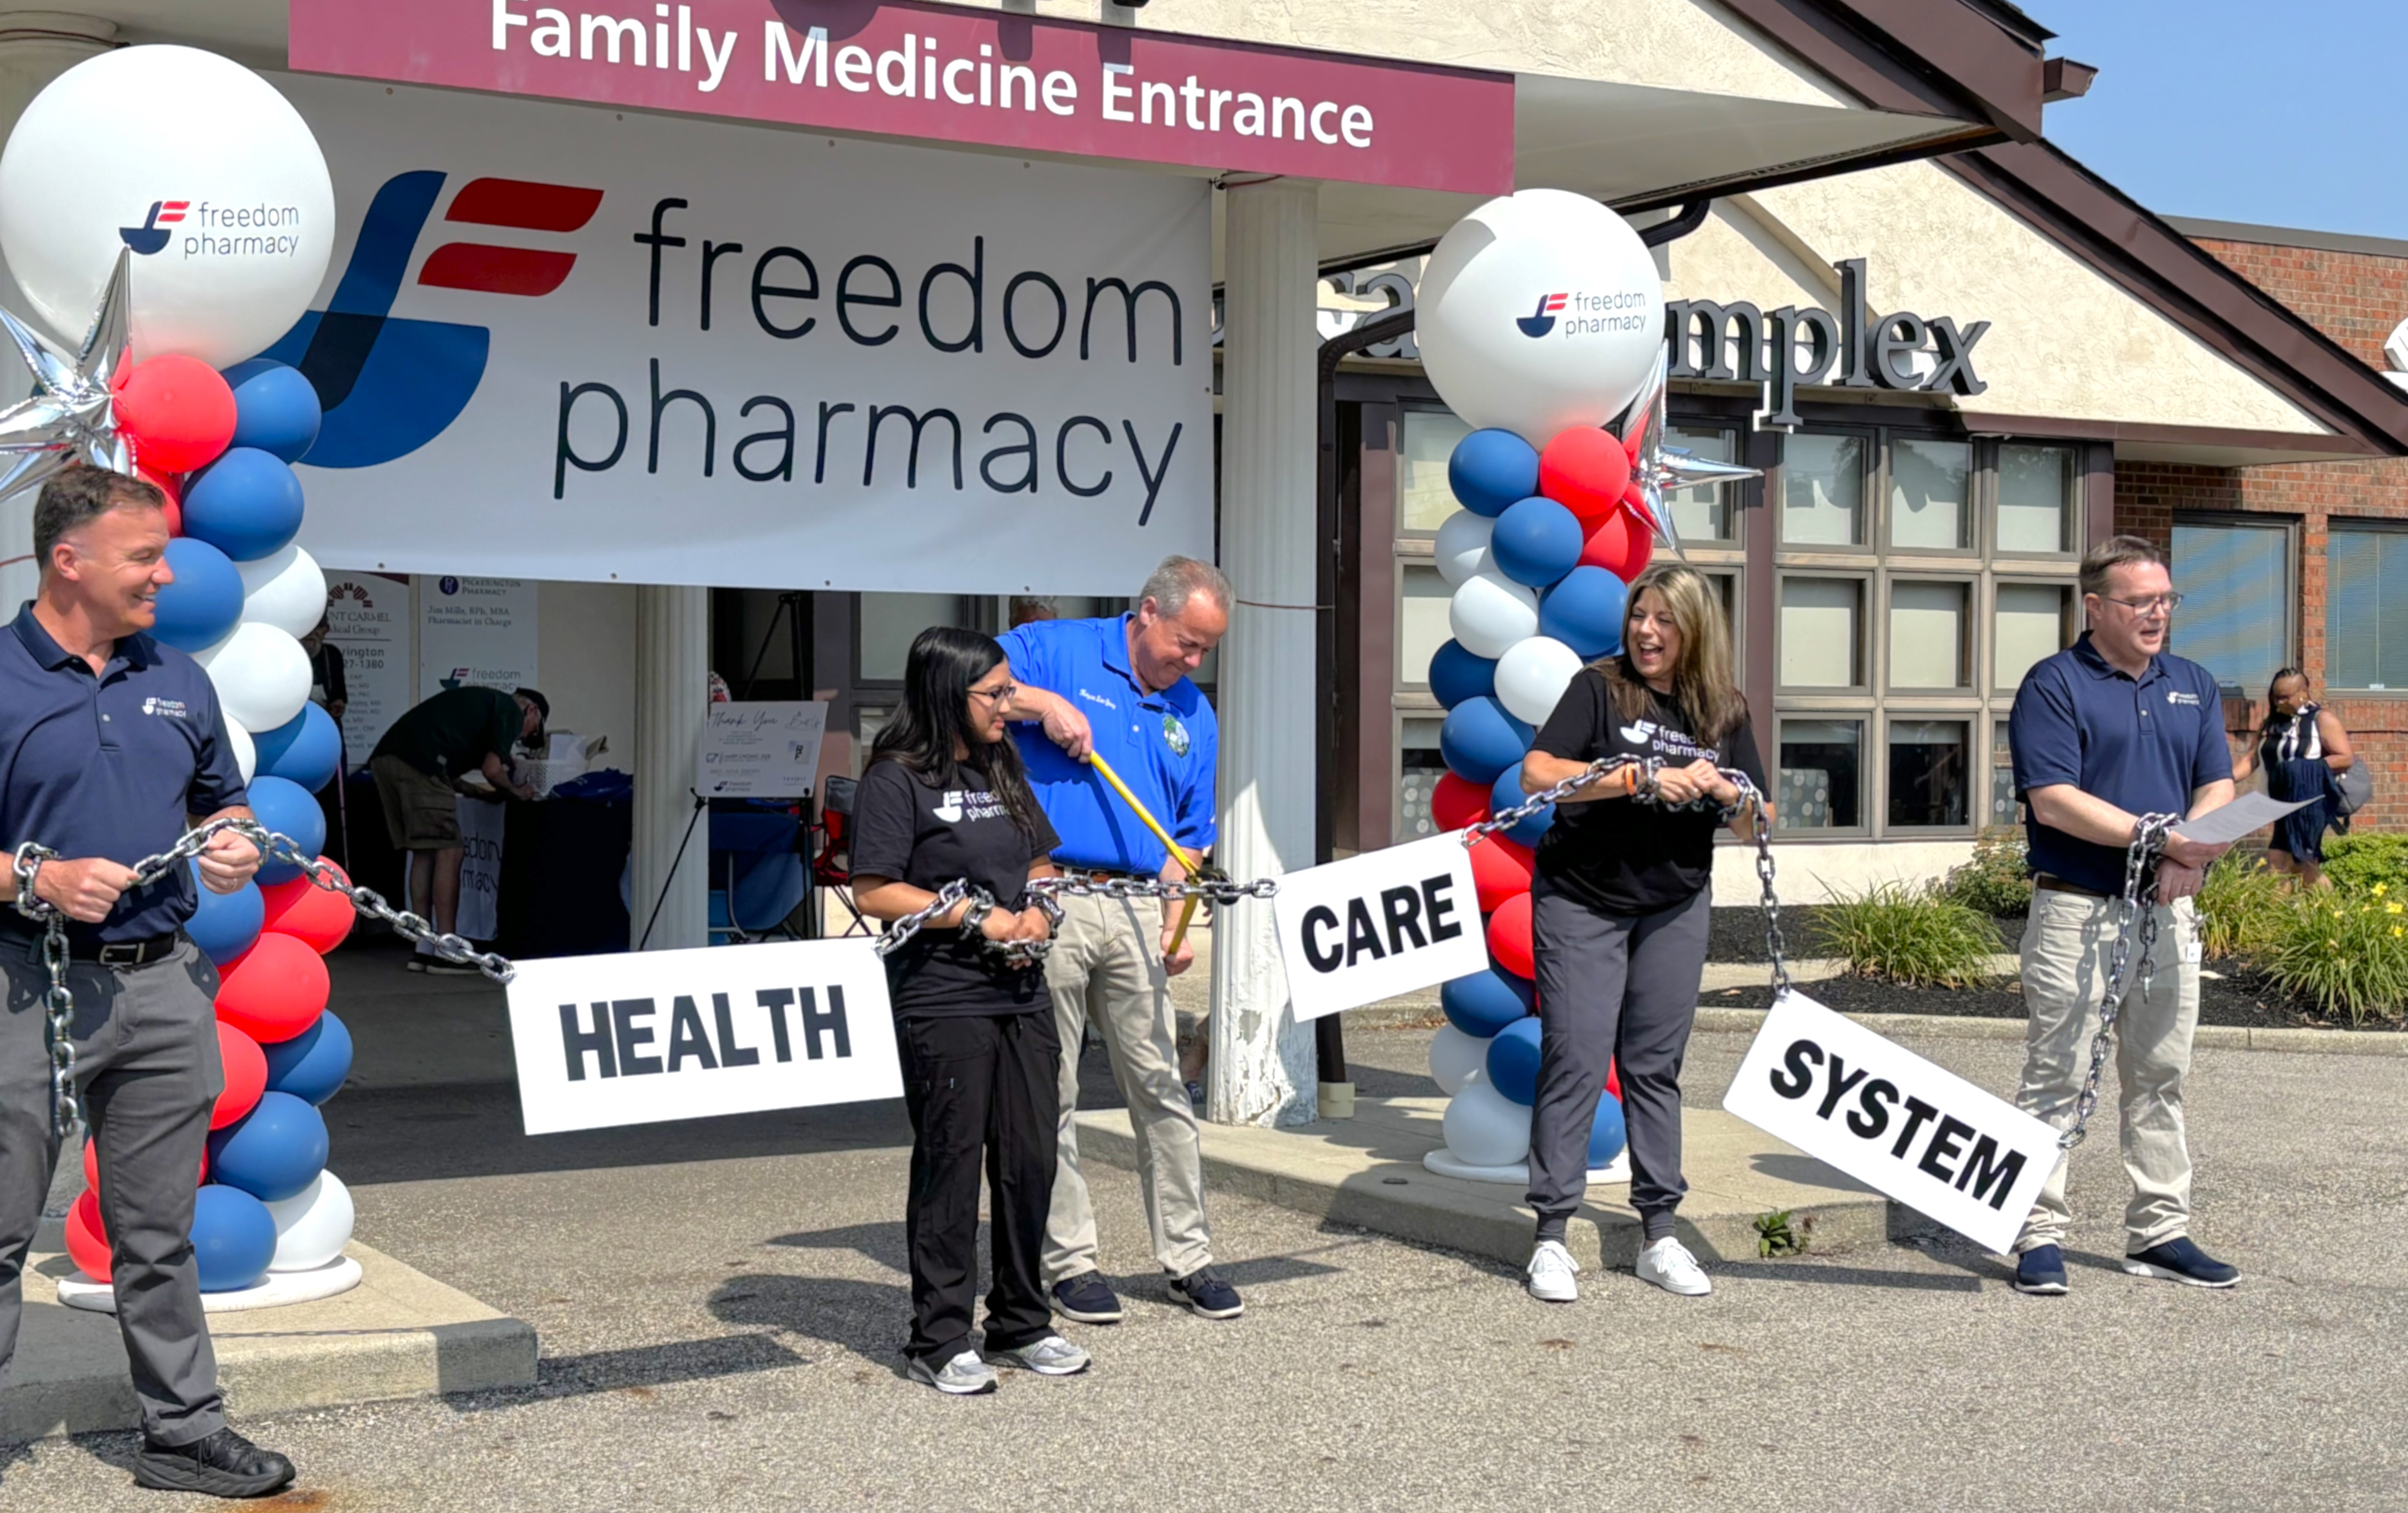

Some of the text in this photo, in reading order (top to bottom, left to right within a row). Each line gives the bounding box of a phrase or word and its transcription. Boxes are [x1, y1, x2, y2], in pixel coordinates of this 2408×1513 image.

[492, 0, 1373, 148] Family Medicine Entrance
[198, 201, 299, 227] freedom
[184, 232, 299, 260] pharmacy
[633, 197, 1182, 366] freedom
[1574, 290, 1645, 312] freedom
[1566, 315, 1646, 339] pharmacy
[1666, 257, 1991, 425] mplex
[554, 358, 1182, 527] pharmacy
[348, 612, 391, 622] CARMEL
[428, 616, 472, 625] Pharmacist
[484, 617, 511, 627] Charge
[490, 608, 509, 616] MBA
[329, 624, 380, 635] dical Group
[342, 646, 384, 658] rington
[343, 659, 384, 669] 27-1380
[473, 668, 521, 680] freedom
[711, 711, 747, 729] Thank
[753, 710, 778, 731] You
[1652, 739, 1720, 763] pharmacy
[1301, 872, 1463, 974] CARE
[559, 985, 852, 1082] HEALTH
[1769, 1039, 2028, 1211] SYSTEM
